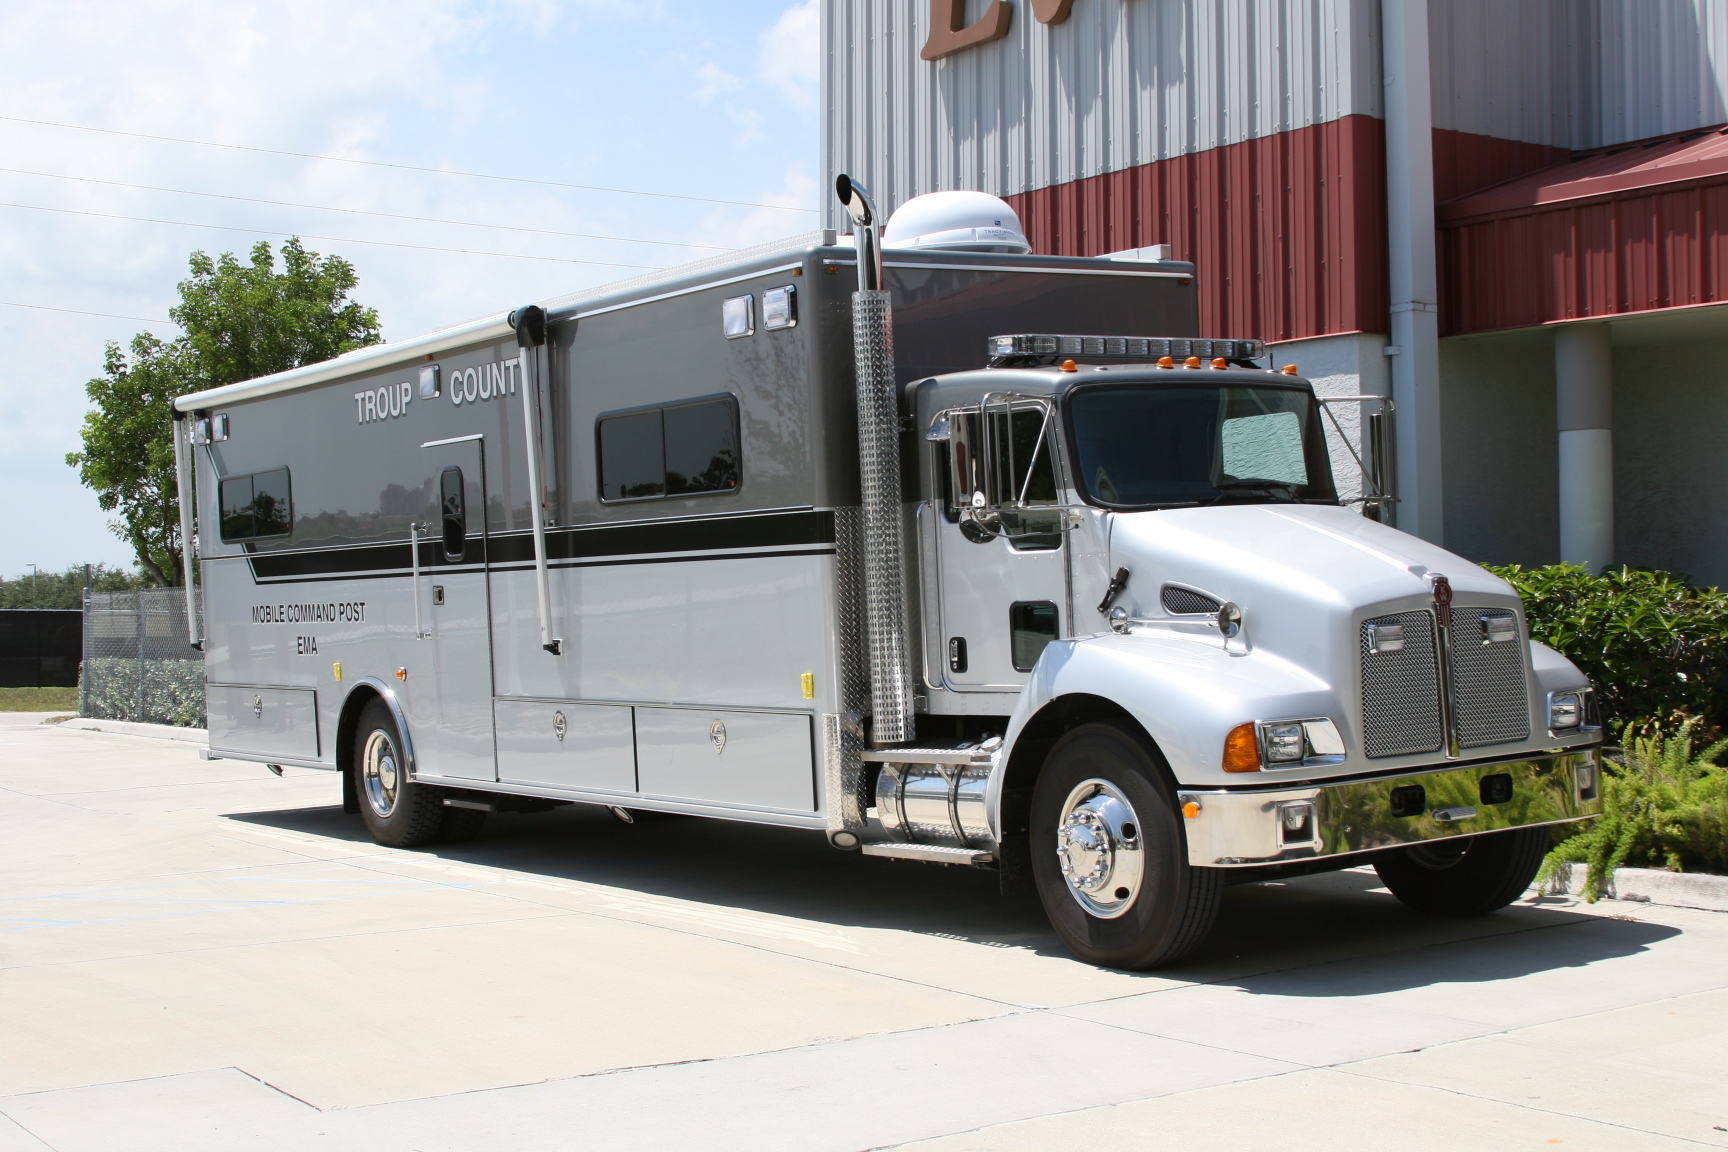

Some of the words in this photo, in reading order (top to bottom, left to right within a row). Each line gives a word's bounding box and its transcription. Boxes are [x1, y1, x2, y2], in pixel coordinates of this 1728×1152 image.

[354, 381, 412, 424] TROUP
[252, 604, 286, 624] MOBILE
[287, 603, 336, 623] COMMAND
[338, 602, 366, 622] POST
[297, 636, 318, 655] EMA
